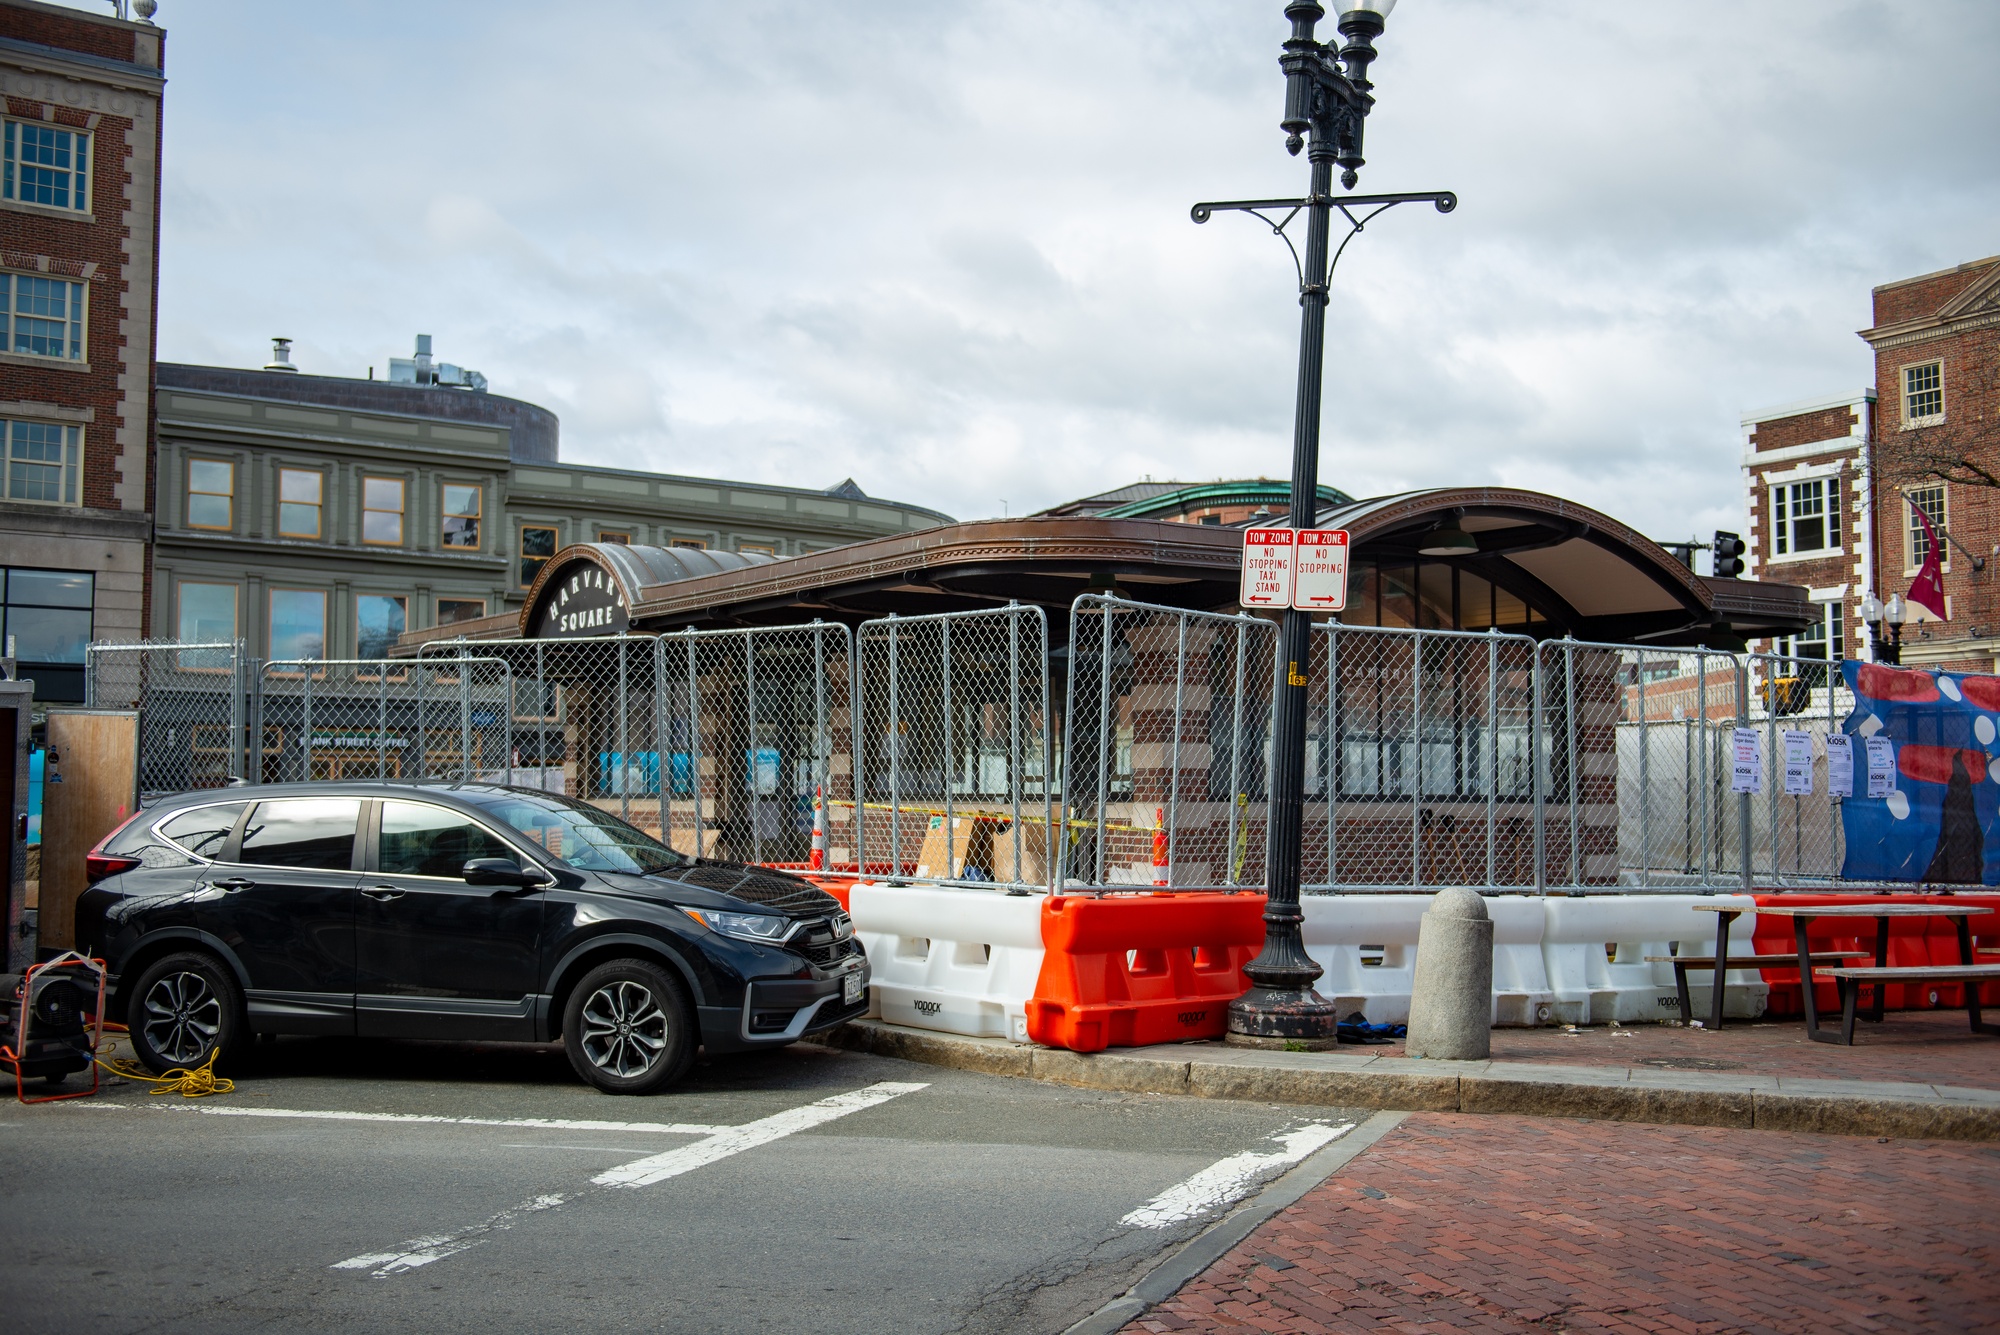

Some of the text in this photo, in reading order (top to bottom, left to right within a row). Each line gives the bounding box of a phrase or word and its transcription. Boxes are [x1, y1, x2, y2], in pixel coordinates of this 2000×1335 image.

[1250, 532, 1290, 543] TOW ZONE
[1303, 533, 1342, 544] TOW ZONE
[1264, 547, 1274, 557] NO
[1315, 549, 1327, 559] NO
[1249, 559, 1287, 569] STOPPING
[1300, 563, 1342, 574] STOPPING
[1259, 570, 1276, 580] TAXI
[1255, 582, 1280, 592] STAND
[560, 605, 613, 632] SQUARE
[299, 737, 409, 747] BANK STREET CFFEE
[914, 1000, 941, 1012] YODOCK
[1657, 996, 1680, 1006] YODOC
[1177, 1010, 1207, 1023] YODOCK
